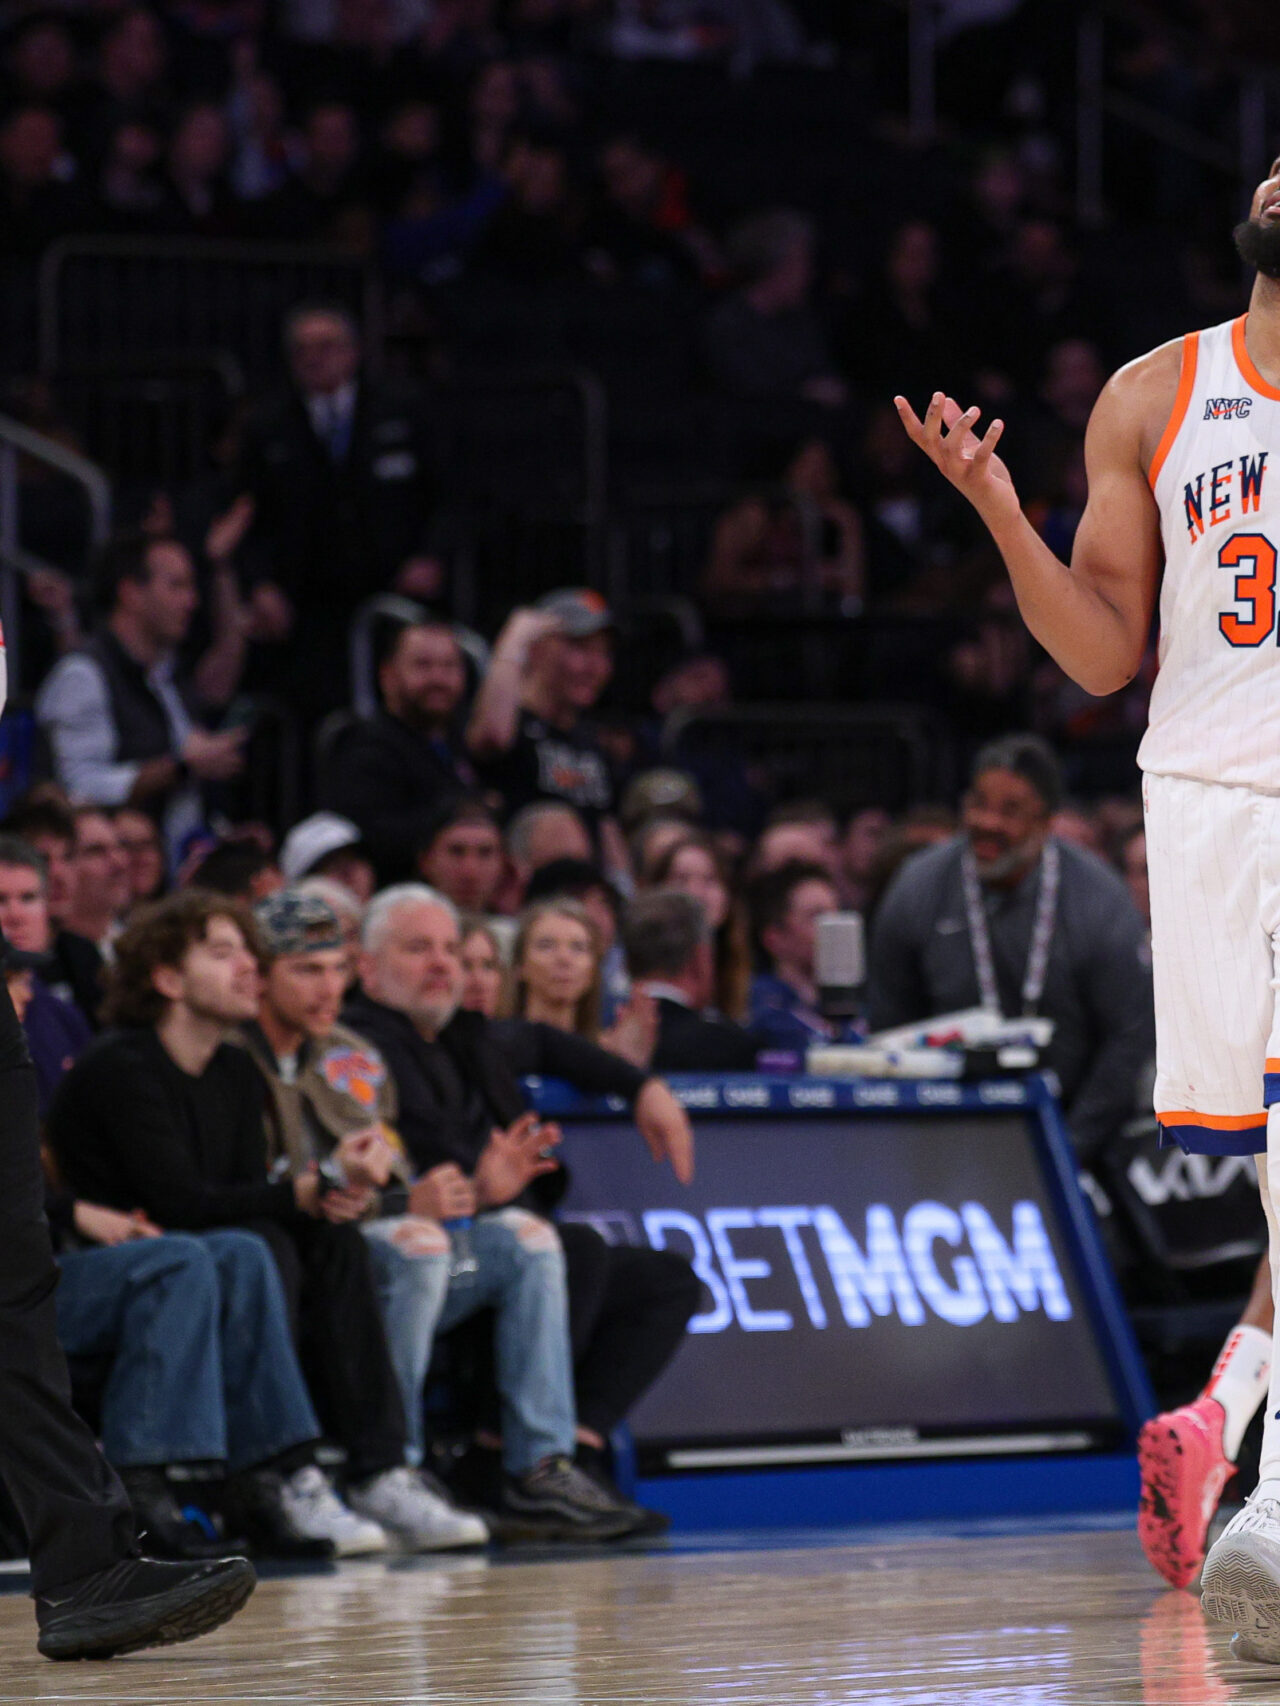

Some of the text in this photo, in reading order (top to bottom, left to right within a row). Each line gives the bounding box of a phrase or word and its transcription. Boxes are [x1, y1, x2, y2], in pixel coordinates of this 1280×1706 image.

[1203, 397, 1253, 420] NYC
[1183, 452, 1269, 545] NEW
[641, 1200, 1073, 1334] BETMGM
